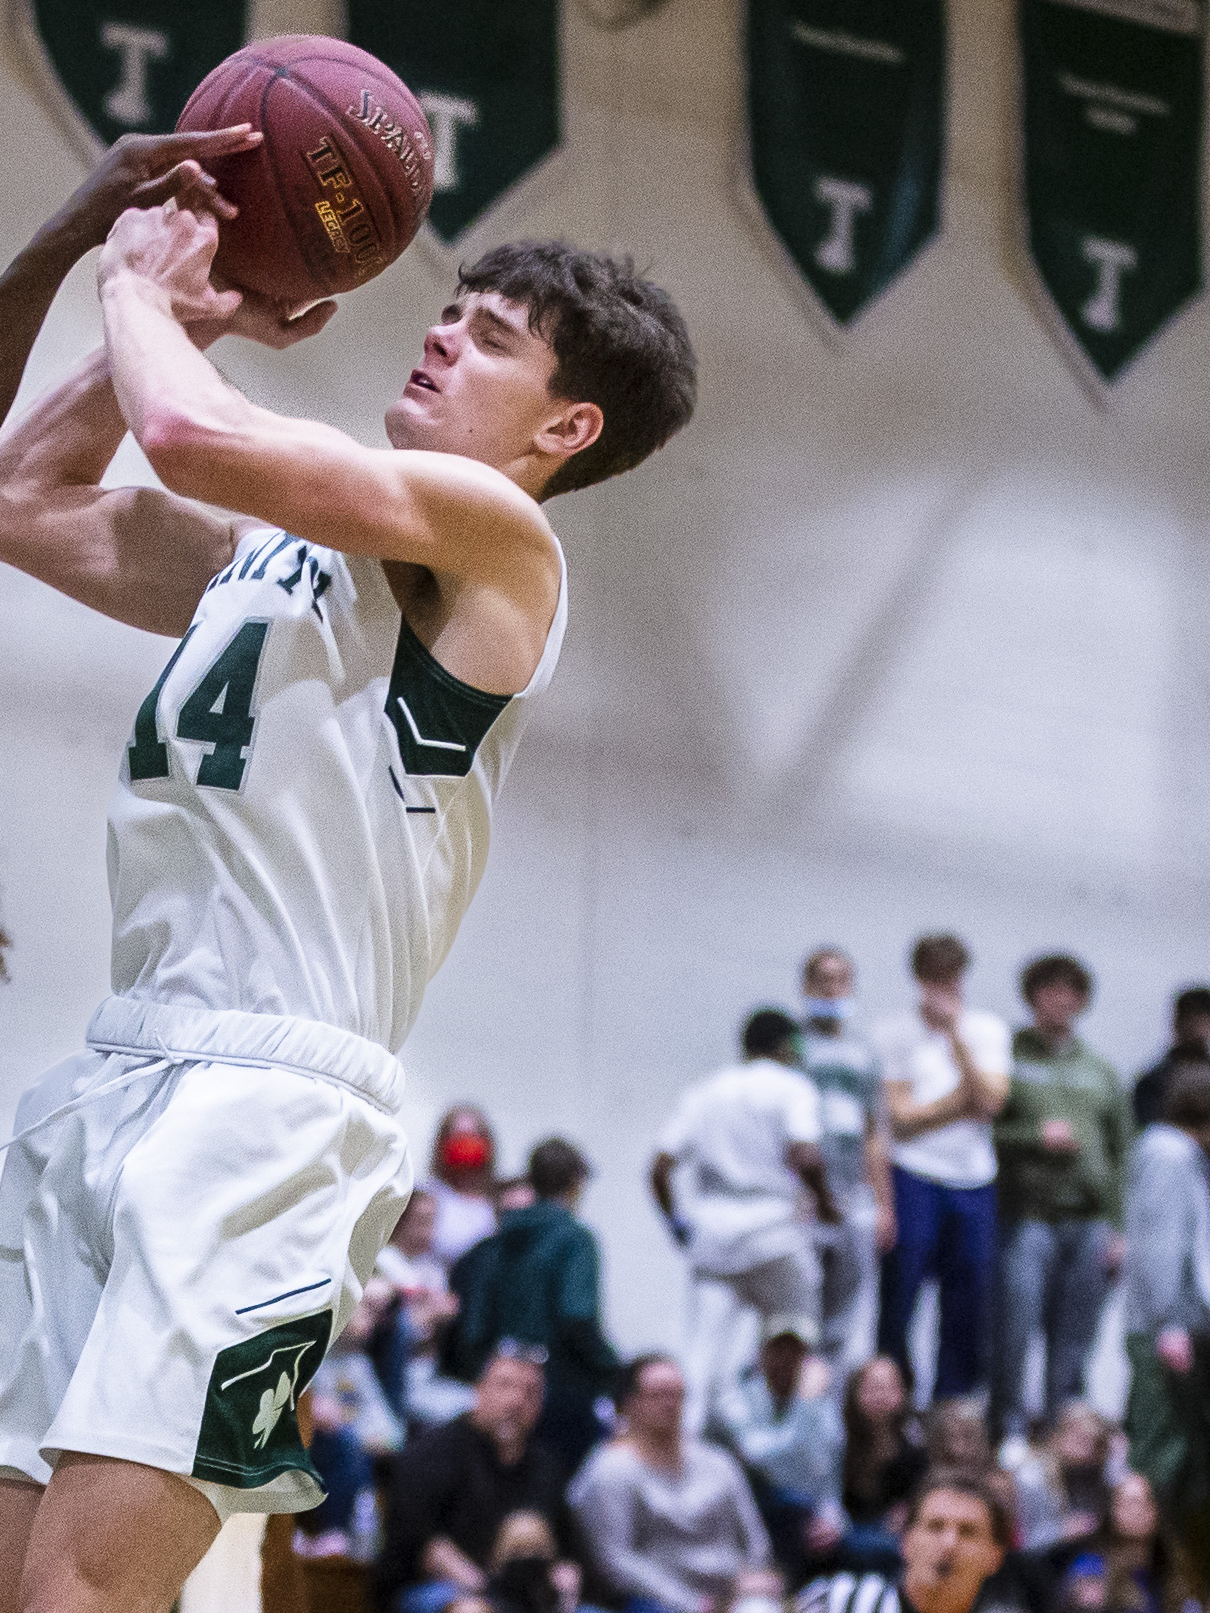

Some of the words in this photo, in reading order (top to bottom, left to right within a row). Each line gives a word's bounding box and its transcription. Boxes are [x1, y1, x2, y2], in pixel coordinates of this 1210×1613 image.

[100, 23, 168, 125] T
[813, 176, 873, 275] T
[1080, 234, 1138, 333] T
[127, 616, 274, 793] 14
